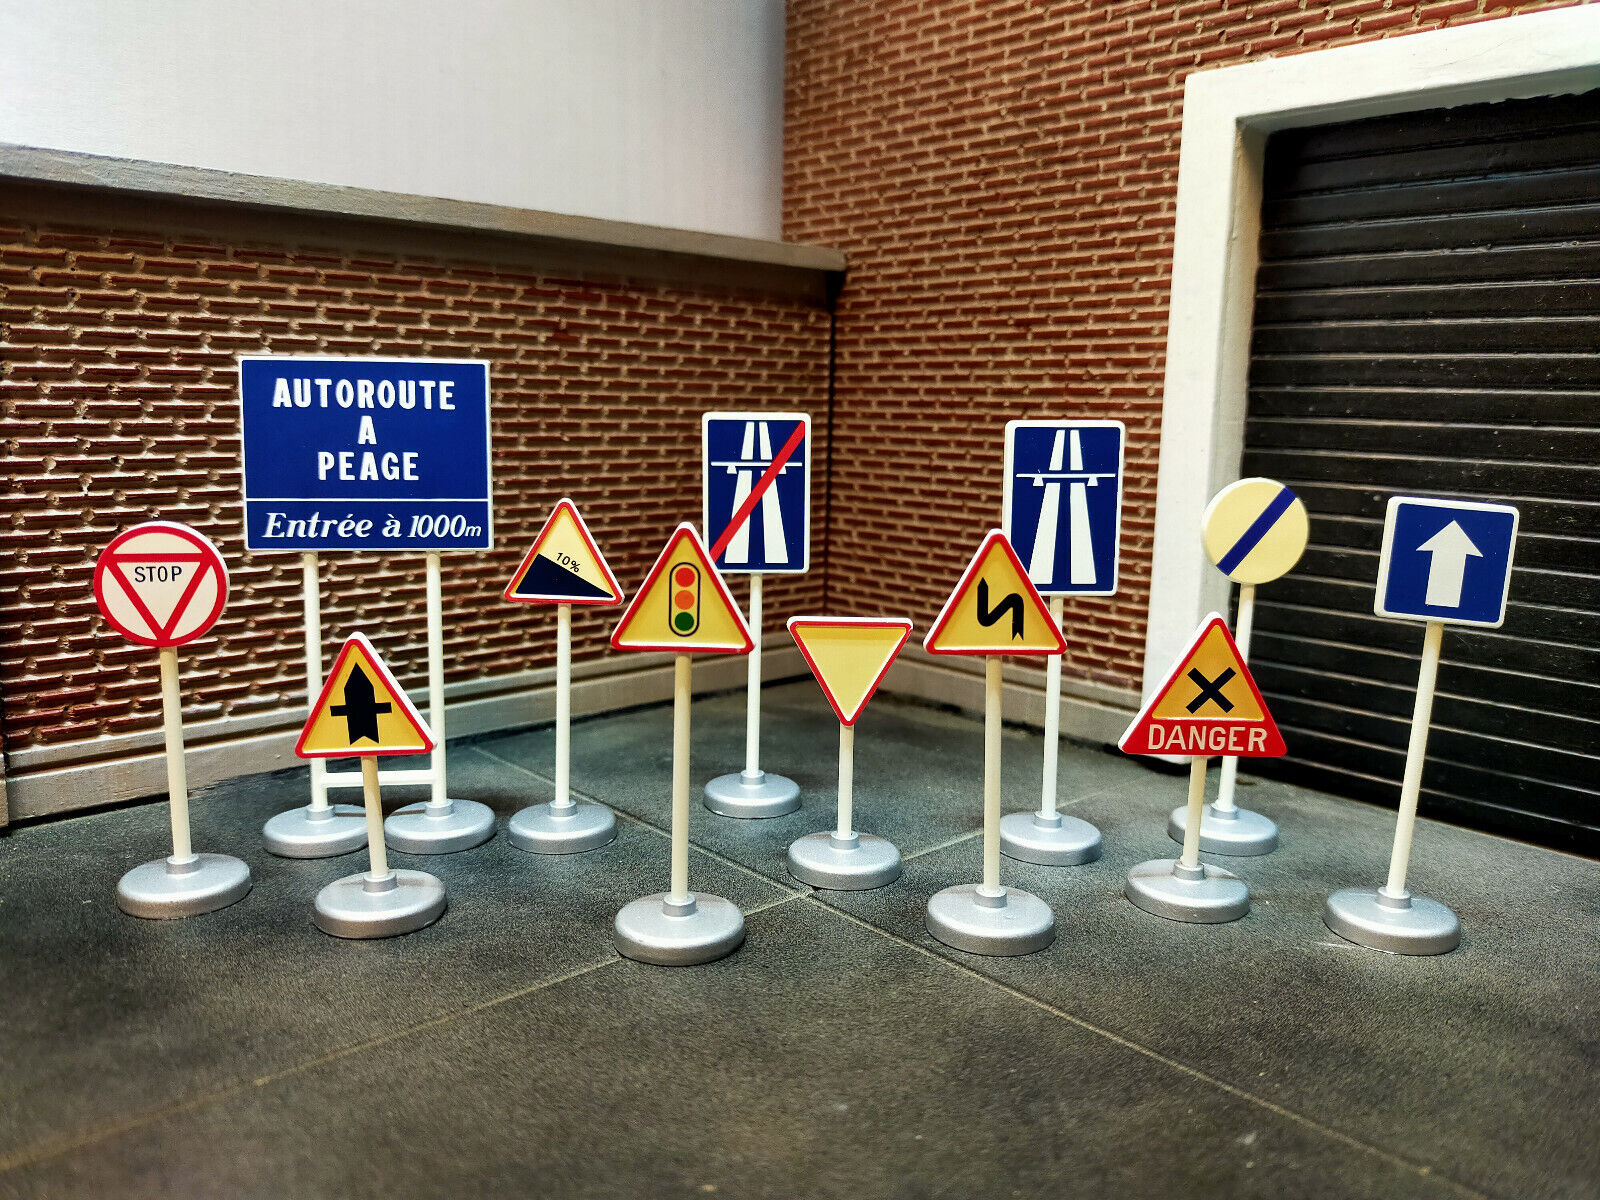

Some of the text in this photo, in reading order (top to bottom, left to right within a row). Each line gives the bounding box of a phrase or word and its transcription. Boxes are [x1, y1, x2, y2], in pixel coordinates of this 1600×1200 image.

[272, 377, 456, 410] AUTOROUTE
[357, 415, 377, 445] A
[317, 451, 420, 481] PEAGE
[262, 511, 373, 538] Entrée
[381, 513, 402, 538] à
[134, 565, 183, 582] STOP
[556, 552, 581, 573] 10%
[1147, 723, 1268, 752] DANGER
